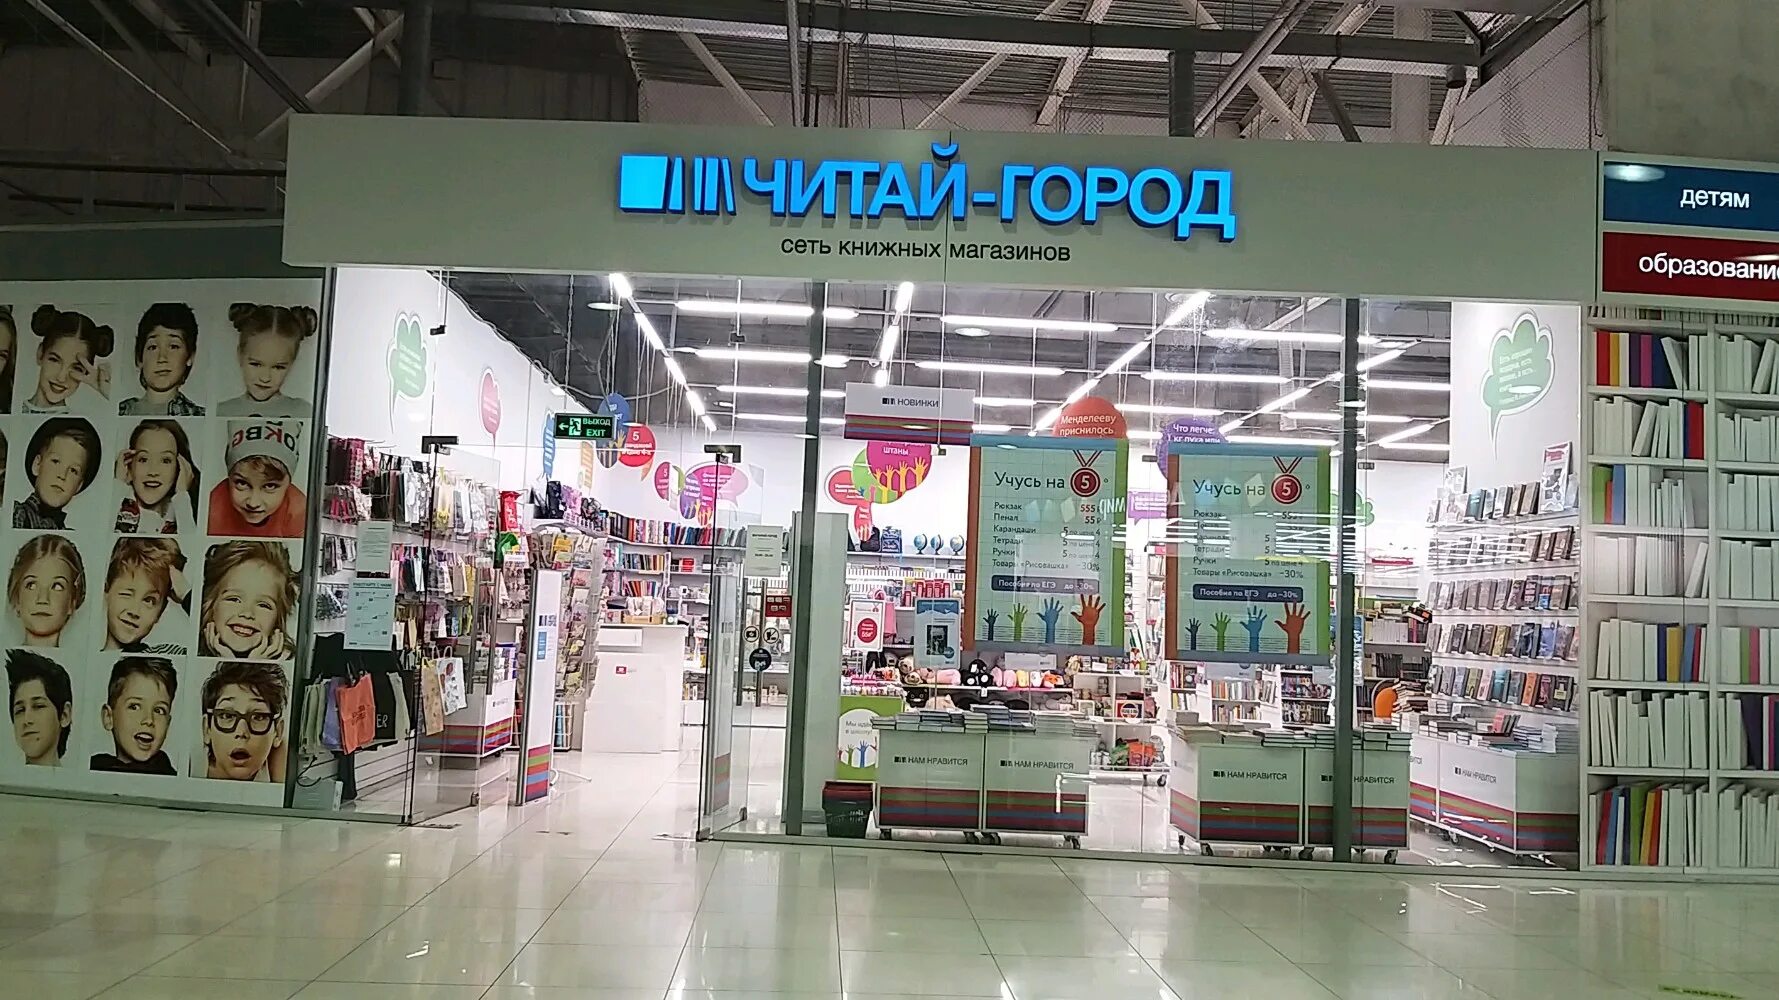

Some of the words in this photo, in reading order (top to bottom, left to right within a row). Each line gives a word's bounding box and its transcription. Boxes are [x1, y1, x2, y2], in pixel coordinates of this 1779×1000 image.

[742, 143, 1237, 241] ЧИТАЙ-ГОРОД
[1680, 188, 1750, 209] детям
[781, 238, 831, 255] сеть
[838, 237, 942, 258] книжных
[949, 241, 1071, 261] магазинов
[1638, 252, 1779, 280] образовани
[897, 398, 939, 408] НОВИНКИ
[582, 417, 611, 426] ВЫХОД
[1061, 415, 1116, 424] Менделееву
[586, 428, 606, 437] EXIT
[1060, 427, 1114, 437] приснилось
[1173, 424, 1188, 433] Что
[632, 431, 640, 441] 5
[883, 447, 908, 455] штаны
[994, 472, 1041, 490] Учусь
[1046, 478, 1065, 488] на
[1193, 479, 1241, 497] Учусь
[1246, 485, 1265, 496] на
[994, 502, 1022, 510] Рюкзак
[1080, 504, 1096, 512] 555
[994, 512, 1018, 521] Пенал
[1085, 516, 1096, 524] 55
[994, 524, 1036, 534] Карандаши
[993, 536, 1024, 545] Тетради
[993, 548, 1015, 556] Ручки
[1193, 556, 1216, 566] Ручки
[1192, 568, 1220, 577] Товары
[998, 579, 1030, 588] Пособия
[1042, 580, 1056, 588] ЕГЭ
[1200, 588, 1232, 597] Пособия
[1244, 589, 1258, 597] ЕГЭ
[908, 756, 926, 764] НАМ
[927, 757, 968, 766] НРАВИТСЯ
[1014, 760, 1032, 768] НАМ
[1033, 761, 1074, 770] НРАВИТСЯ
[1246, 772, 1287, 780] НРАВИТСЯ
[1354, 776, 1394, 784] НРАВИТСЯ
